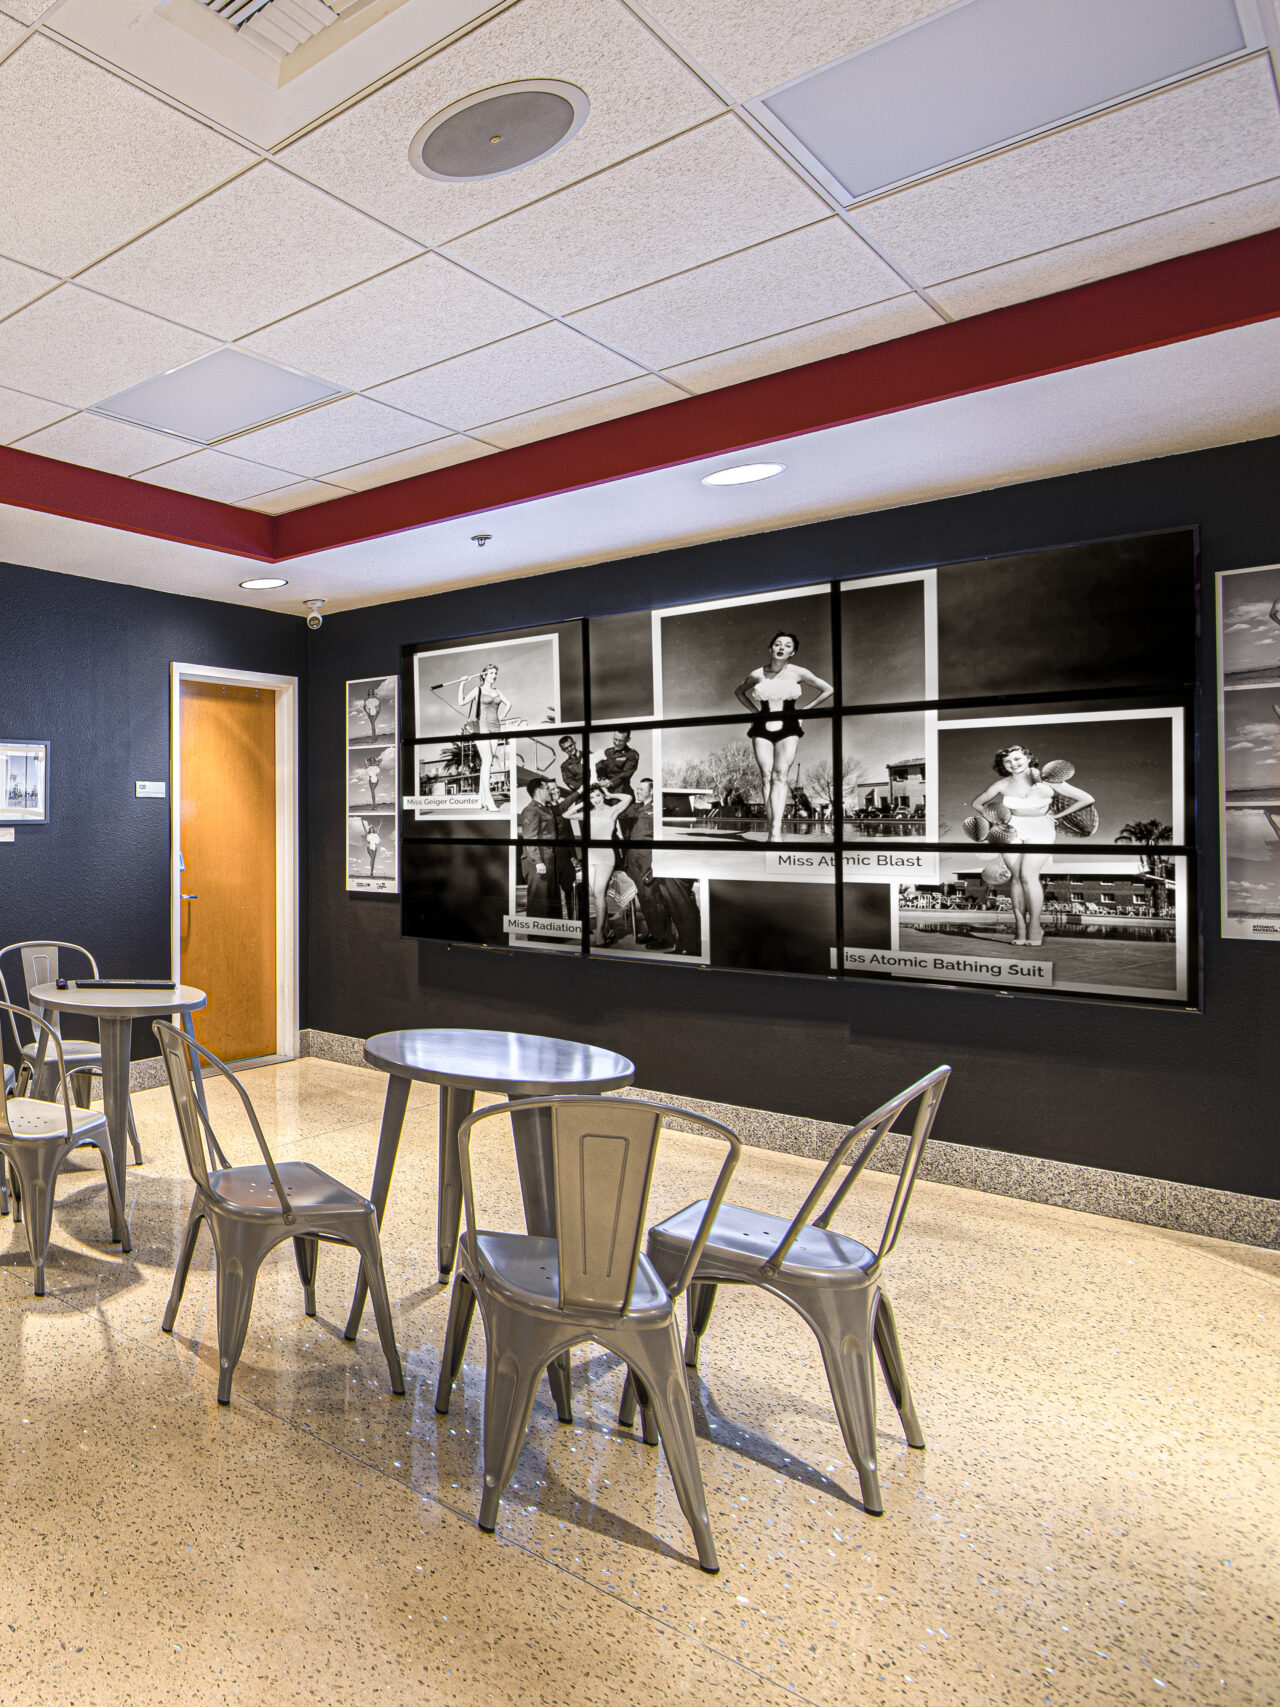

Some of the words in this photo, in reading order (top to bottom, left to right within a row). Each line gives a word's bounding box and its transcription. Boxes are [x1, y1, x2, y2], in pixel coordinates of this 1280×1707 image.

[423, 798, 448, 806] Geiger
[778, 854, 814, 867] Miss
[818, 854, 871, 867] Atmic
[877, 854, 923, 867] Blast
[508, 919, 530, 929] Miss
[532, 920, 582, 933] Radiation
[844, 951, 866, 964] iss
[869, 953, 928, 969] Atomic
[933, 958, 1002, 977] Bathing
[1007, 964, 1045, 978] Suit
